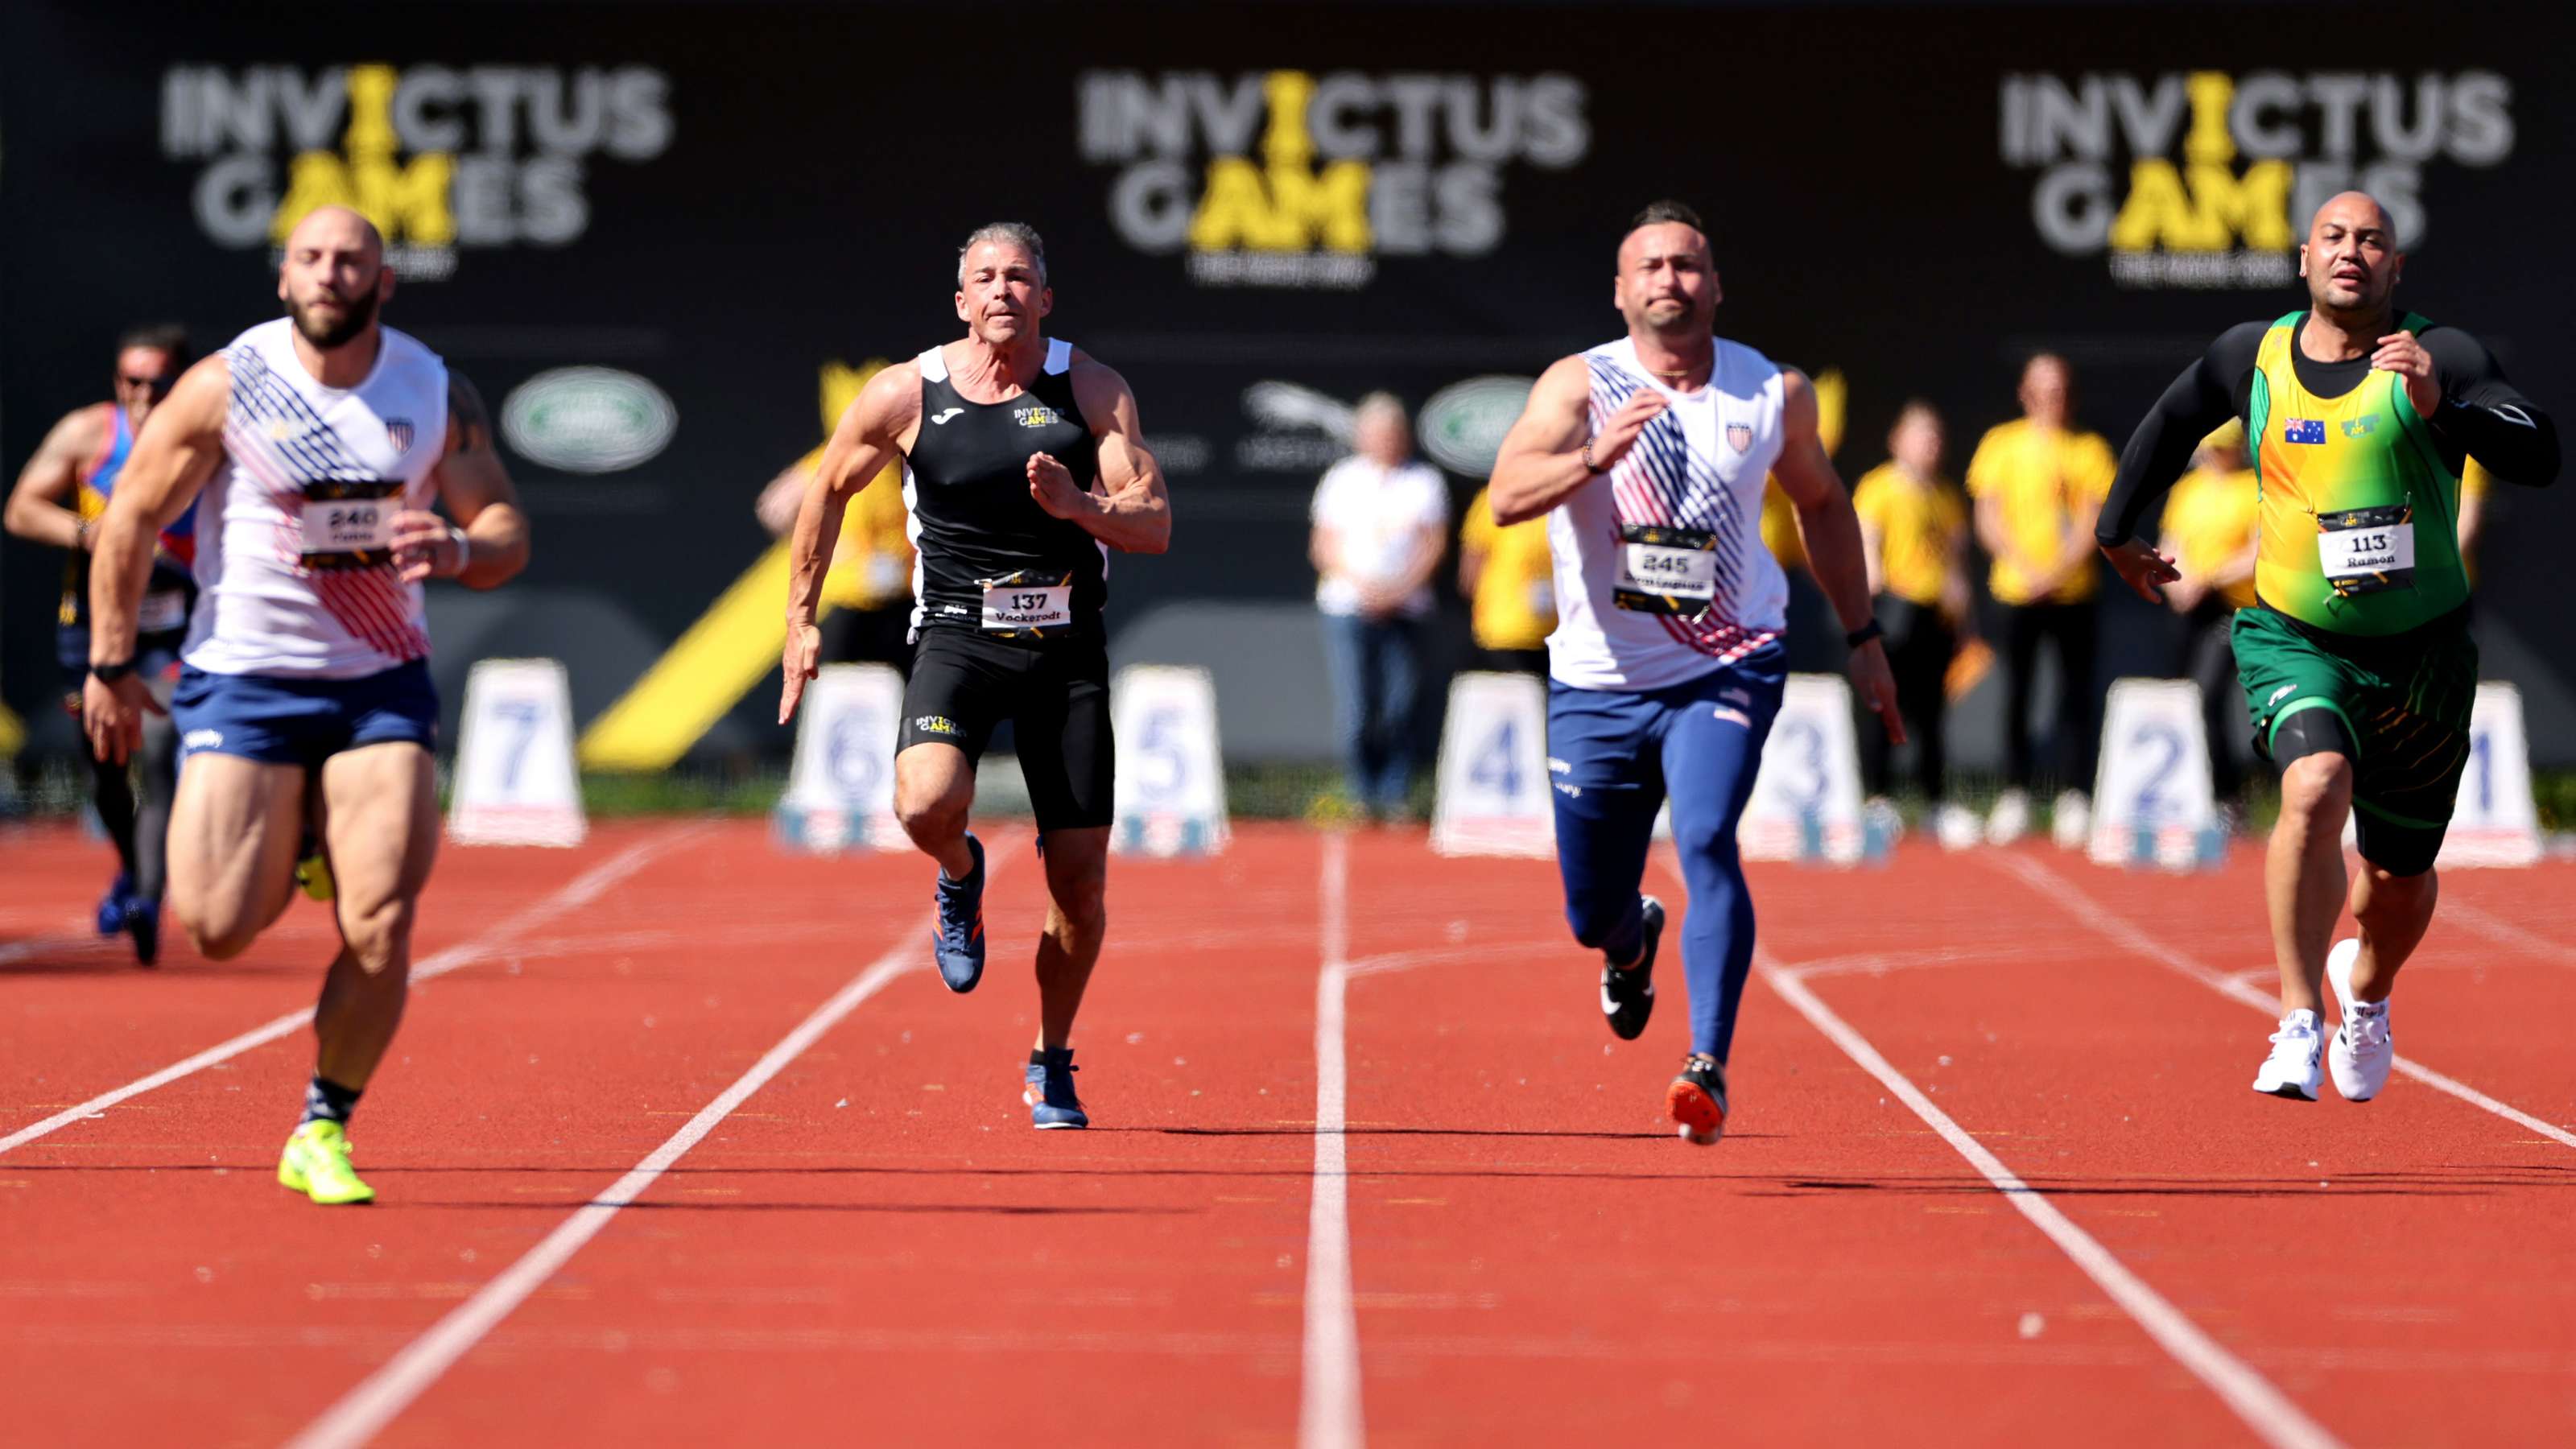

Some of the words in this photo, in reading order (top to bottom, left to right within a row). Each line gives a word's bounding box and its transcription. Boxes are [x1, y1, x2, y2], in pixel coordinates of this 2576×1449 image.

[162, 64, 673, 159] INVICTUS
[1080, 69, 1587, 166] INVICTUS
[2001, 72, 2513, 164] INVICTUS
[194, 151, 588, 248] GAMES
[1111, 155, 1504, 256] GAMES
[1014, 407, 1063, 419] INVICT
[1019, 415, 1059, 426] GAMES
[329, 509, 378, 528] 240
[2347, 555, 2395, 567] Ramon
[2352, 535, 2386, 552] 113
[1012, 593, 1048, 609] 137
[1643, 555, 1688, 573] 245
[996, 612, 1061, 623] Vockerodt
[493, 702, 539, 791] 7
[829, 705, 881, 797] 6
[1139, 707, 1187, 800] 5
[1468, 718, 1524, 800] 4
[1780, 717, 1828, 807] 3
[2130, 726, 2184, 815] 2
[2471, 731, 2492, 813] 1
